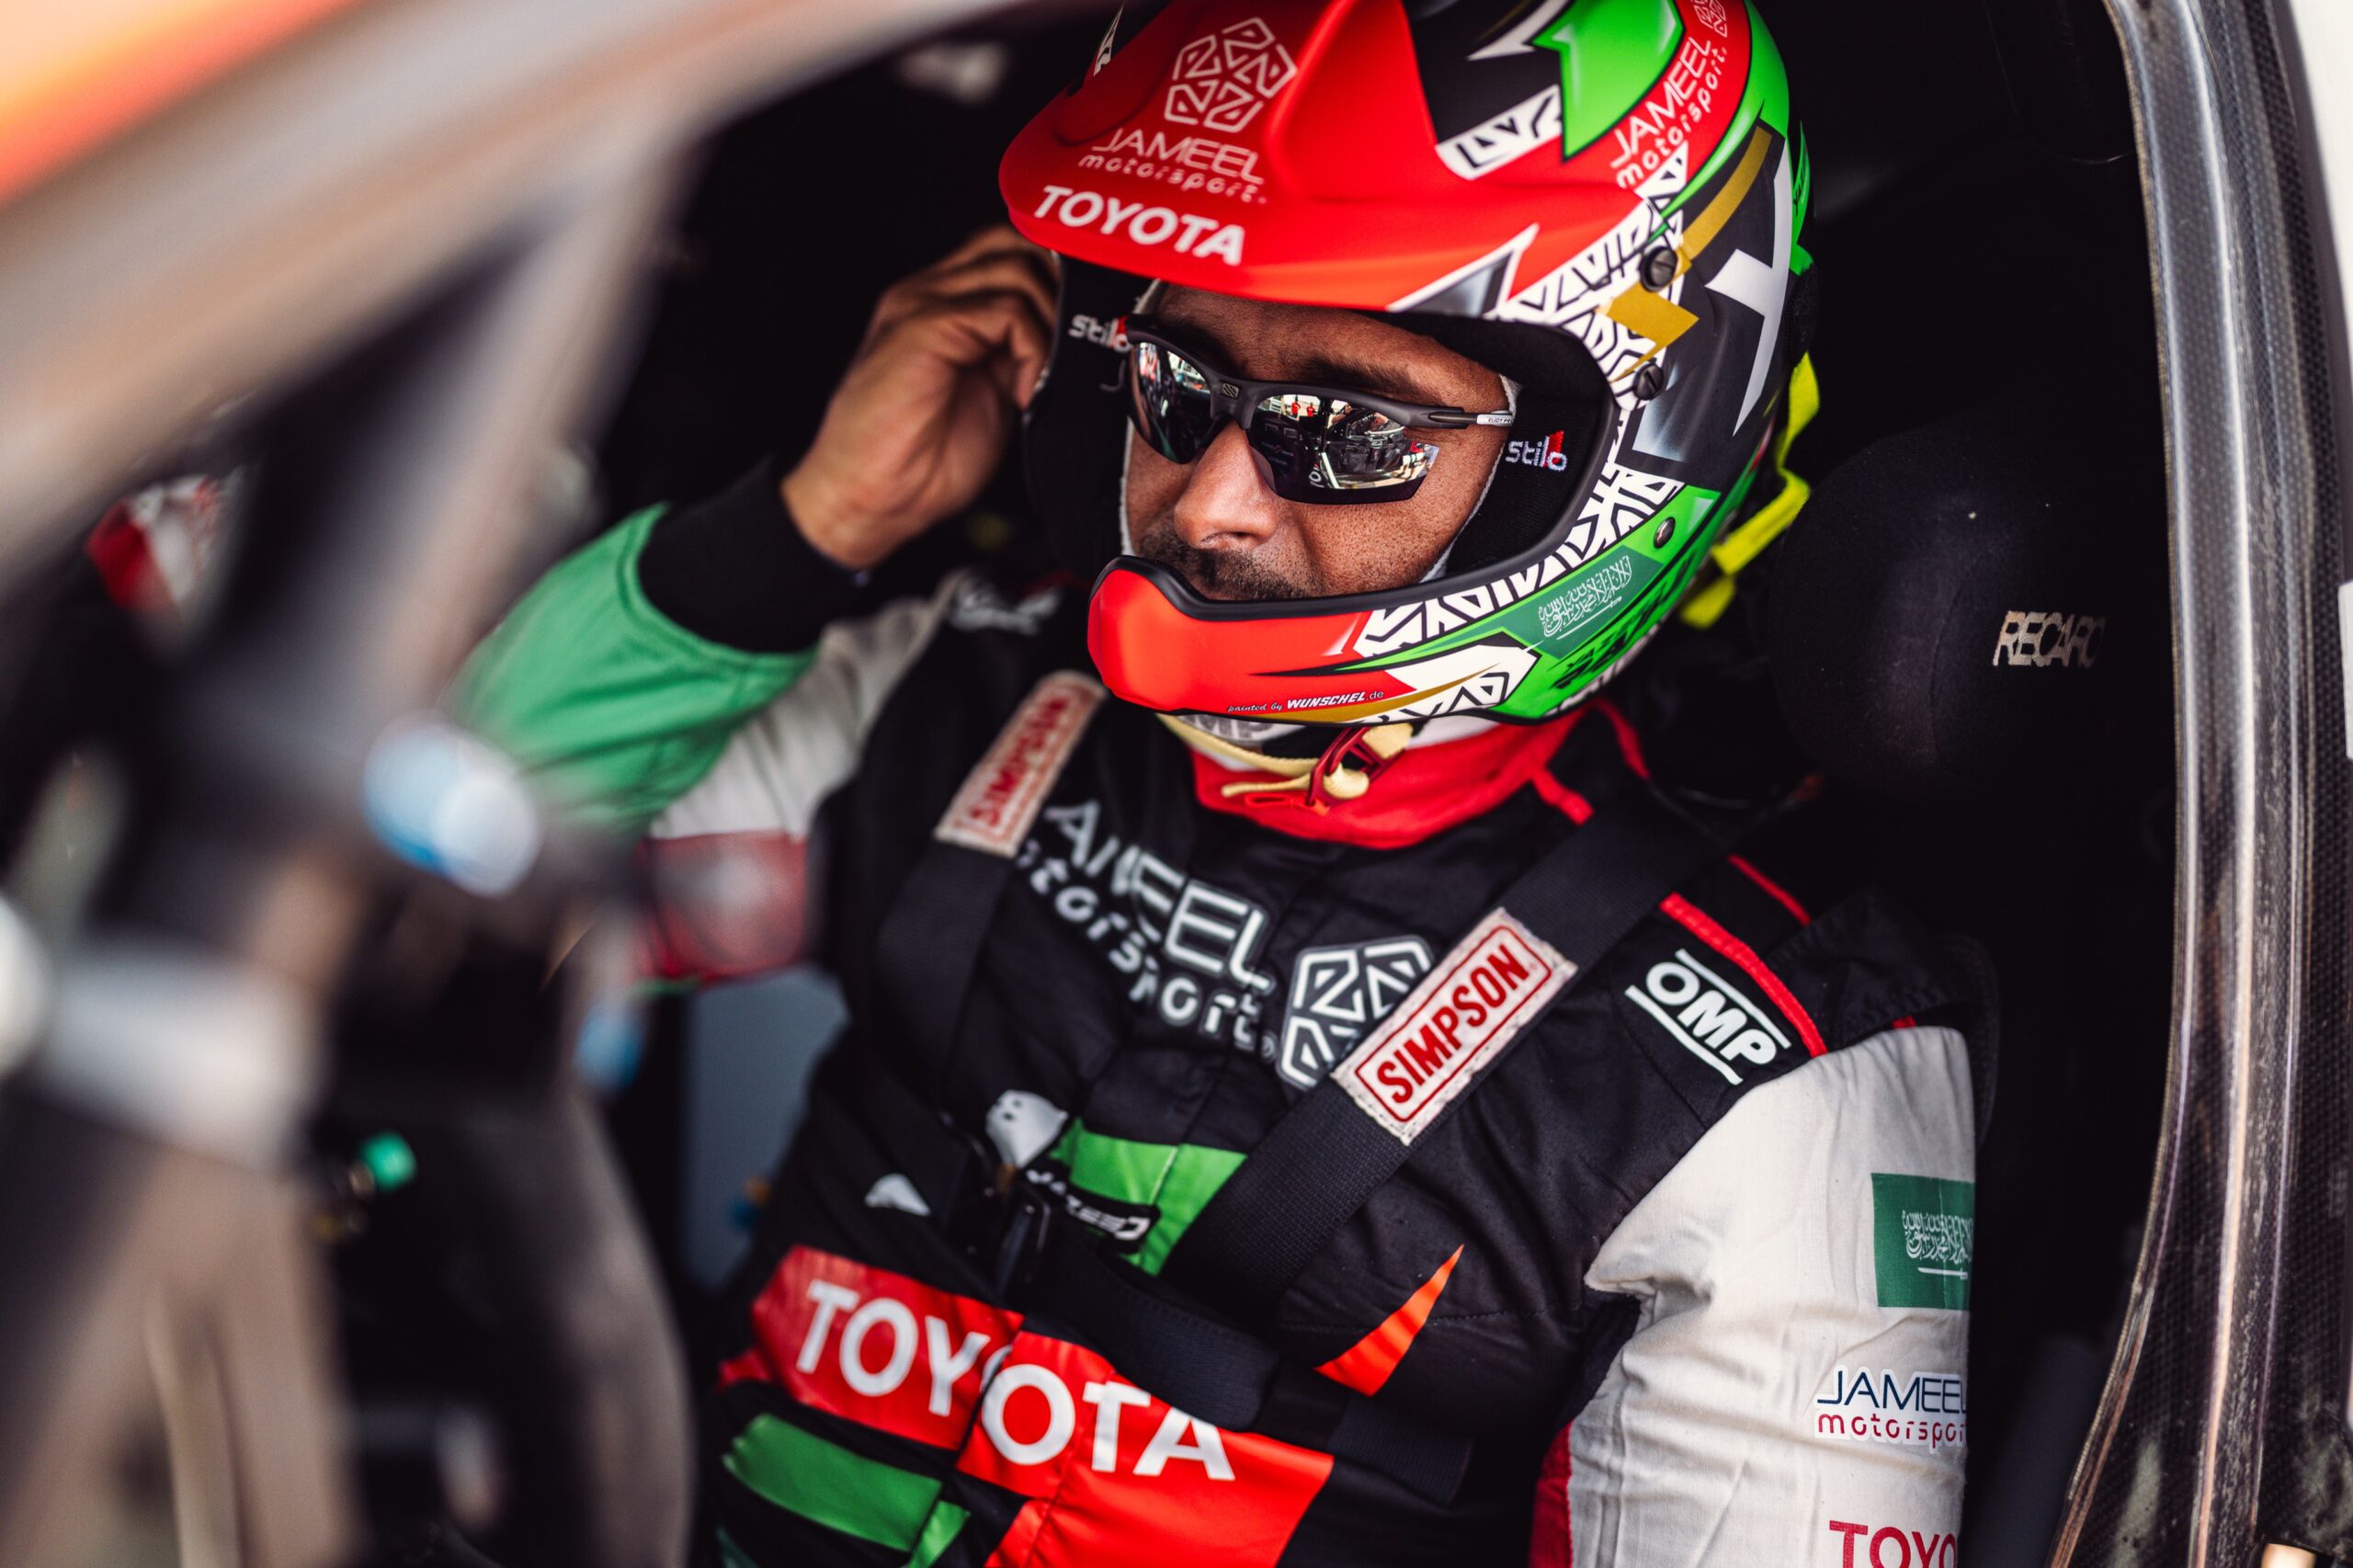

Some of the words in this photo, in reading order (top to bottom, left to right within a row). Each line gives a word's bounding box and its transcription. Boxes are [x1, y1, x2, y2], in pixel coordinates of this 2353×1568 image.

[1610, 35, 1713, 168] JAMEEL
[1616, 48, 1725, 189] motorsport
[1078, 153, 1261, 204] motorsport
[1092, 128, 1265, 185] JAMEEL
[1033, 185, 1245, 267] TOYOTA
[1505, 434, 1568, 472] stilo
[1992, 610, 2108, 668] RECARO
[1227, 703, 1267, 712] painted
[1270, 702, 1283, 711] by
[1287, 690, 1384, 710] WUNSCHEL.de
[1376, 943, 1531, 1104] SIMPSON
[1645, 961, 1779, 1066] OMP
[797, 1278, 1236, 1483] TOYOTA
[1816, 1369, 1967, 1415] JAMEEL
[1817, 1413, 1967, 1449] motorspor
[1828, 1519, 1957, 1568] TOYO
